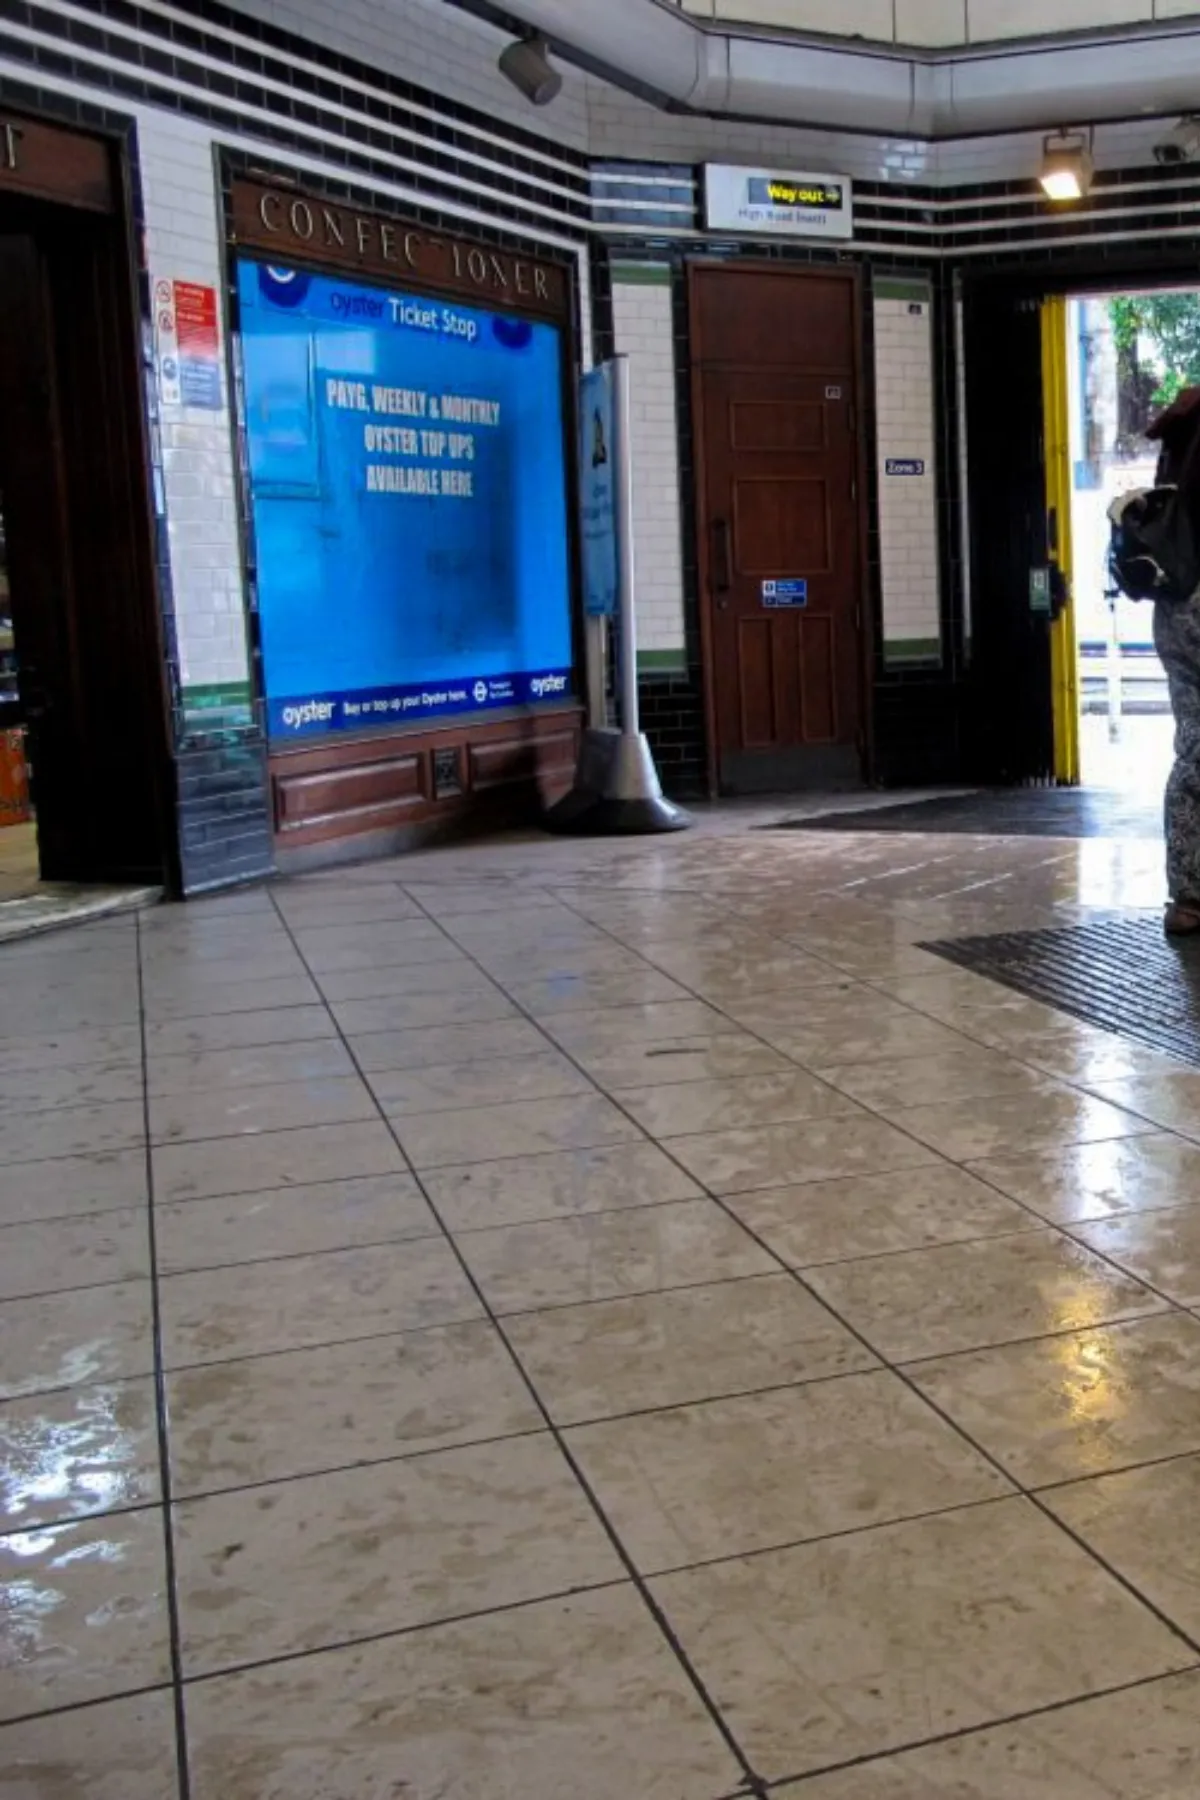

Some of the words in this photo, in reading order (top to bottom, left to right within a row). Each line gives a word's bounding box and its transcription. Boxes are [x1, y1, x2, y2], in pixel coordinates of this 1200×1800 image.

[767, 184, 797, 203] Way
[799, 189, 825, 202] out
[331, 292, 384, 318] oyster
[387, 297, 438, 328] Ticket
[443, 308, 477, 342] Stop
[372, 384, 427, 418] WEEKLY
[429, 396, 440, 420] &
[441, 394, 501, 427] MONTHLY
[364, 424, 419, 457] OYSTER
[420, 429, 447, 457] TOP
[448, 433, 475, 460] UPS
[366, 464, 439, 496] AVAILABLE
[441, 469, 473, 497] HERE
[888, 459, 914, 474] Zone
[916, 460, 923, 474] 3
[530, 673, 567, 697] oyster
[283, 699, 336, 729] oyster
